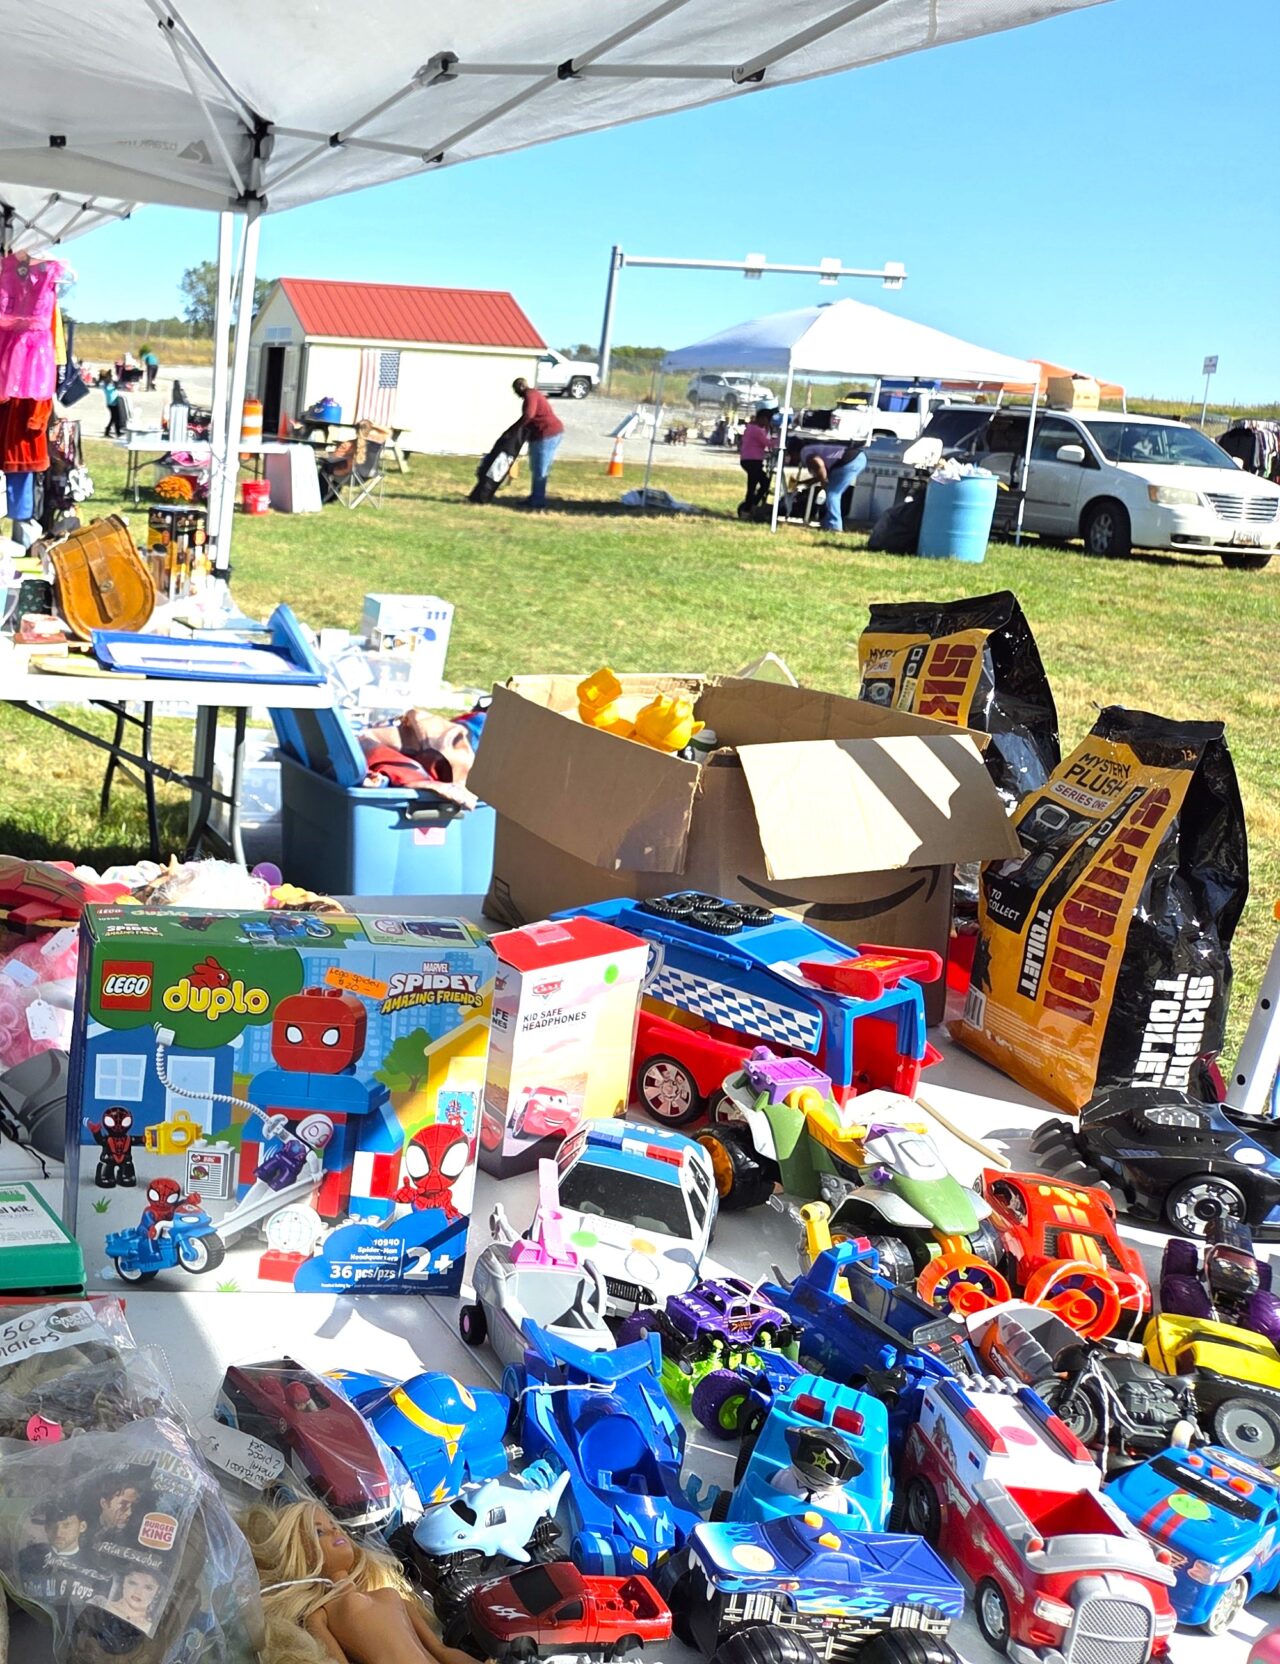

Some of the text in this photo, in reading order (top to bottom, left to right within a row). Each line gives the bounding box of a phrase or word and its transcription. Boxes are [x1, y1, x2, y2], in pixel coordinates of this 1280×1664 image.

[1079, 753, 1131, 778] MYSTERY
[1063, 763, 1128, 797] PLUSH
[1054, 784, 1109, 811] SERIES ONE
[991, 888, 1002, 900] TO
[989, 899, 1021, 922] COLLECT
[1042, 788, 1172, 1027] SKIBIDI
[1020, 908, 1052, 998] TOILET
[423, 961, 450, 973] MARVEL
[104, 974, 150, 997] LEGO
[389, 973, 479, 996] SPIDEY
[163, 978, 270, 1021] duplo
[380, 989, 484, 1015] AMAZING FRIENDS
[522, 1011, 587, 1032] HEADPHONES
[523, 1007, 563, 1023] KID SAFE
[10, 1204, 35, 1214] kit.
[373, 1238, 400, 1246] 10940
[329, 1265, 396, 1282] 36 pcs/pzs
[403, 1246, 454, 1281] 2+
[247, 1448, 273, 1467] piece
[141, 1527, 173, 1543] KING
[143, 1519, 175, 1532] BURGER
[71, 1580, 95, 1600] Toys
